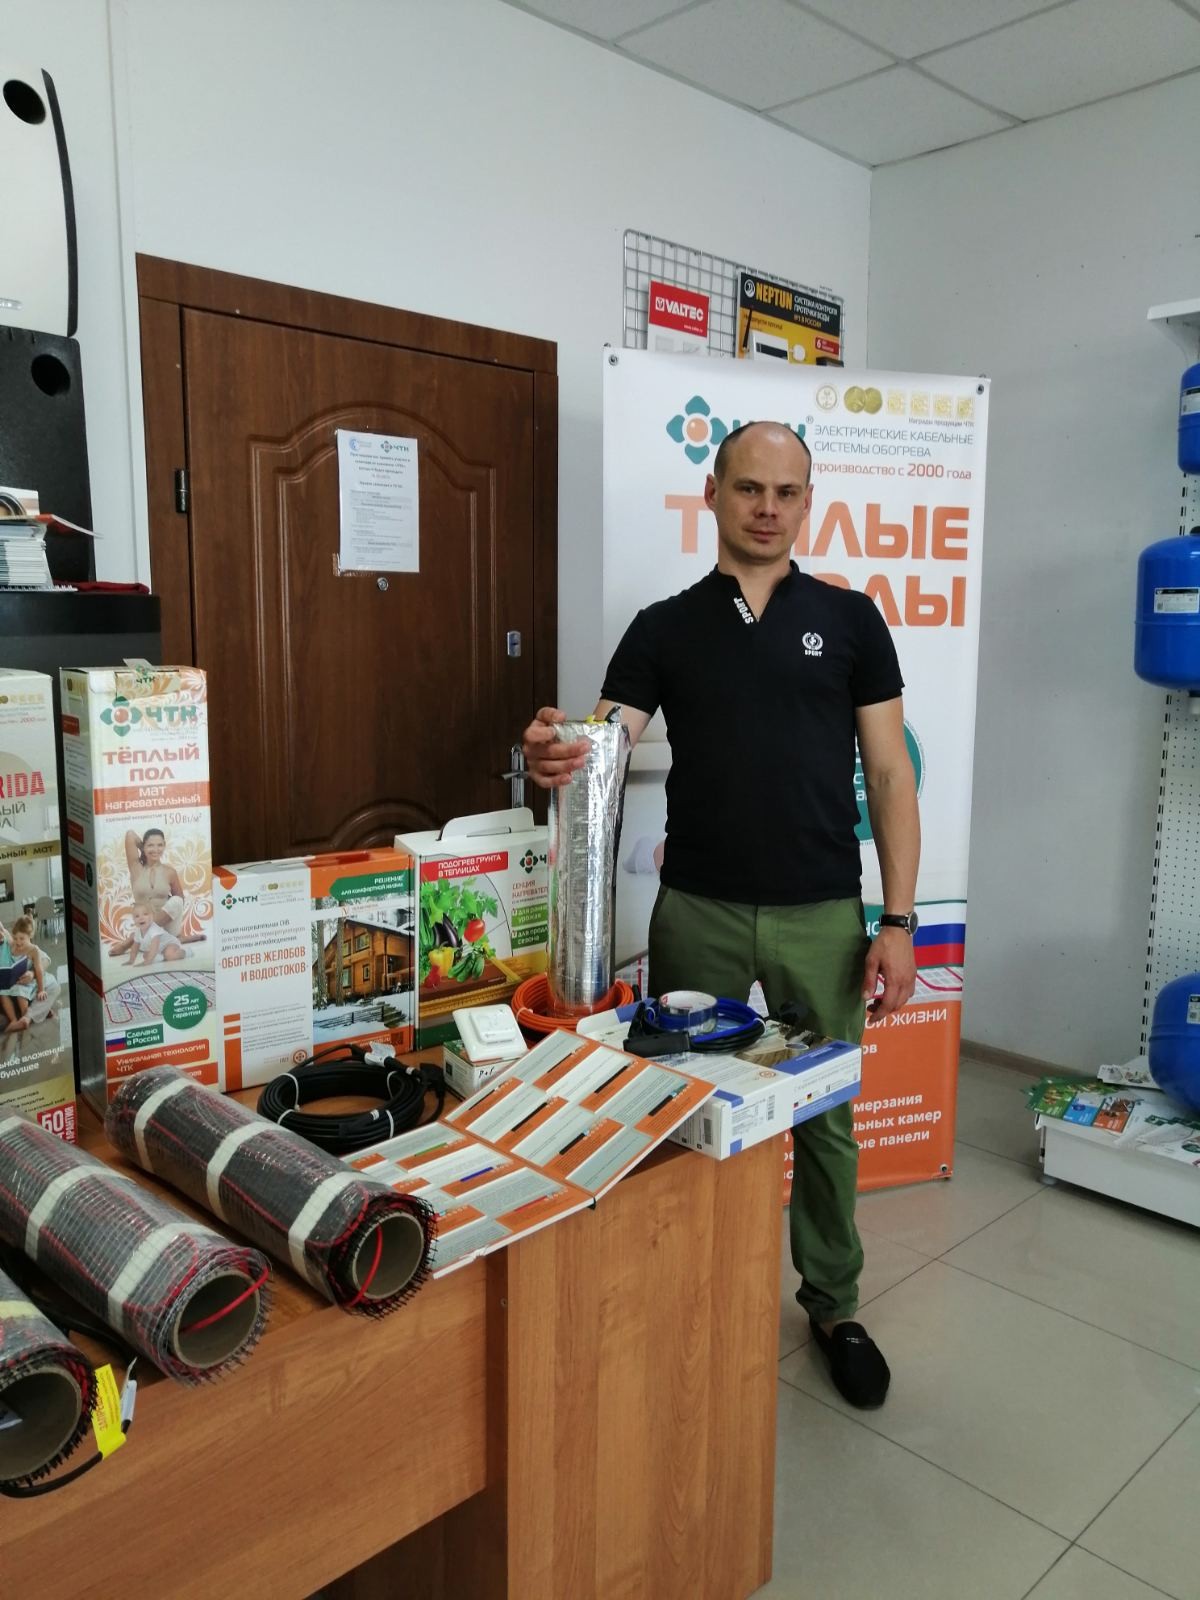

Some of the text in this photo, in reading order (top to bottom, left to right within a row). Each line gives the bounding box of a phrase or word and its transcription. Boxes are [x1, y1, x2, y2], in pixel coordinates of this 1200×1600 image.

[755, 282, 793, 311] NEPTUN
[664, 299, 704, 321] VALTEC
[815, 425, 908, 441] ЭЛЕКТРИЧЕСКИЕ
[910, 431, 974, 445] КАБЕЛЬНЫЕ
[814, 441, 931, 457] СИСТЕМЫ ОБОГРЕВА
[812, 462, 972, 480] производство с 2000 года
[665, 494, 970, 560] ТЛЫЕ
[733, 597, 754, 624] SPORT
[804, 649, 823, 657] SPORT
[136, 676, 155, 685] ЧТК
[145, 705, 197, 723] ЧТК
[104, 793, 201, 812] нагревательный
[438, 854, 501, 870] ПОДОГРЕВ ГРУНТА
[438, 865, 480, 878] В ТЕПЛИЦАХ
[238, 895, 258, 903] ЧТК
[221, 945, 306, 969] ОБОГРЕВ ЖЕЛОБОВ
[240, 961, 307, 982] И ВОДОСТОКОВ
[173, 994, 190, 1006] 25
[890, 1008, 947, 1027] ЖИЗНИ
[898, 1109, 943, 1124] камер
[879, 1130, 930, 1147] панели
